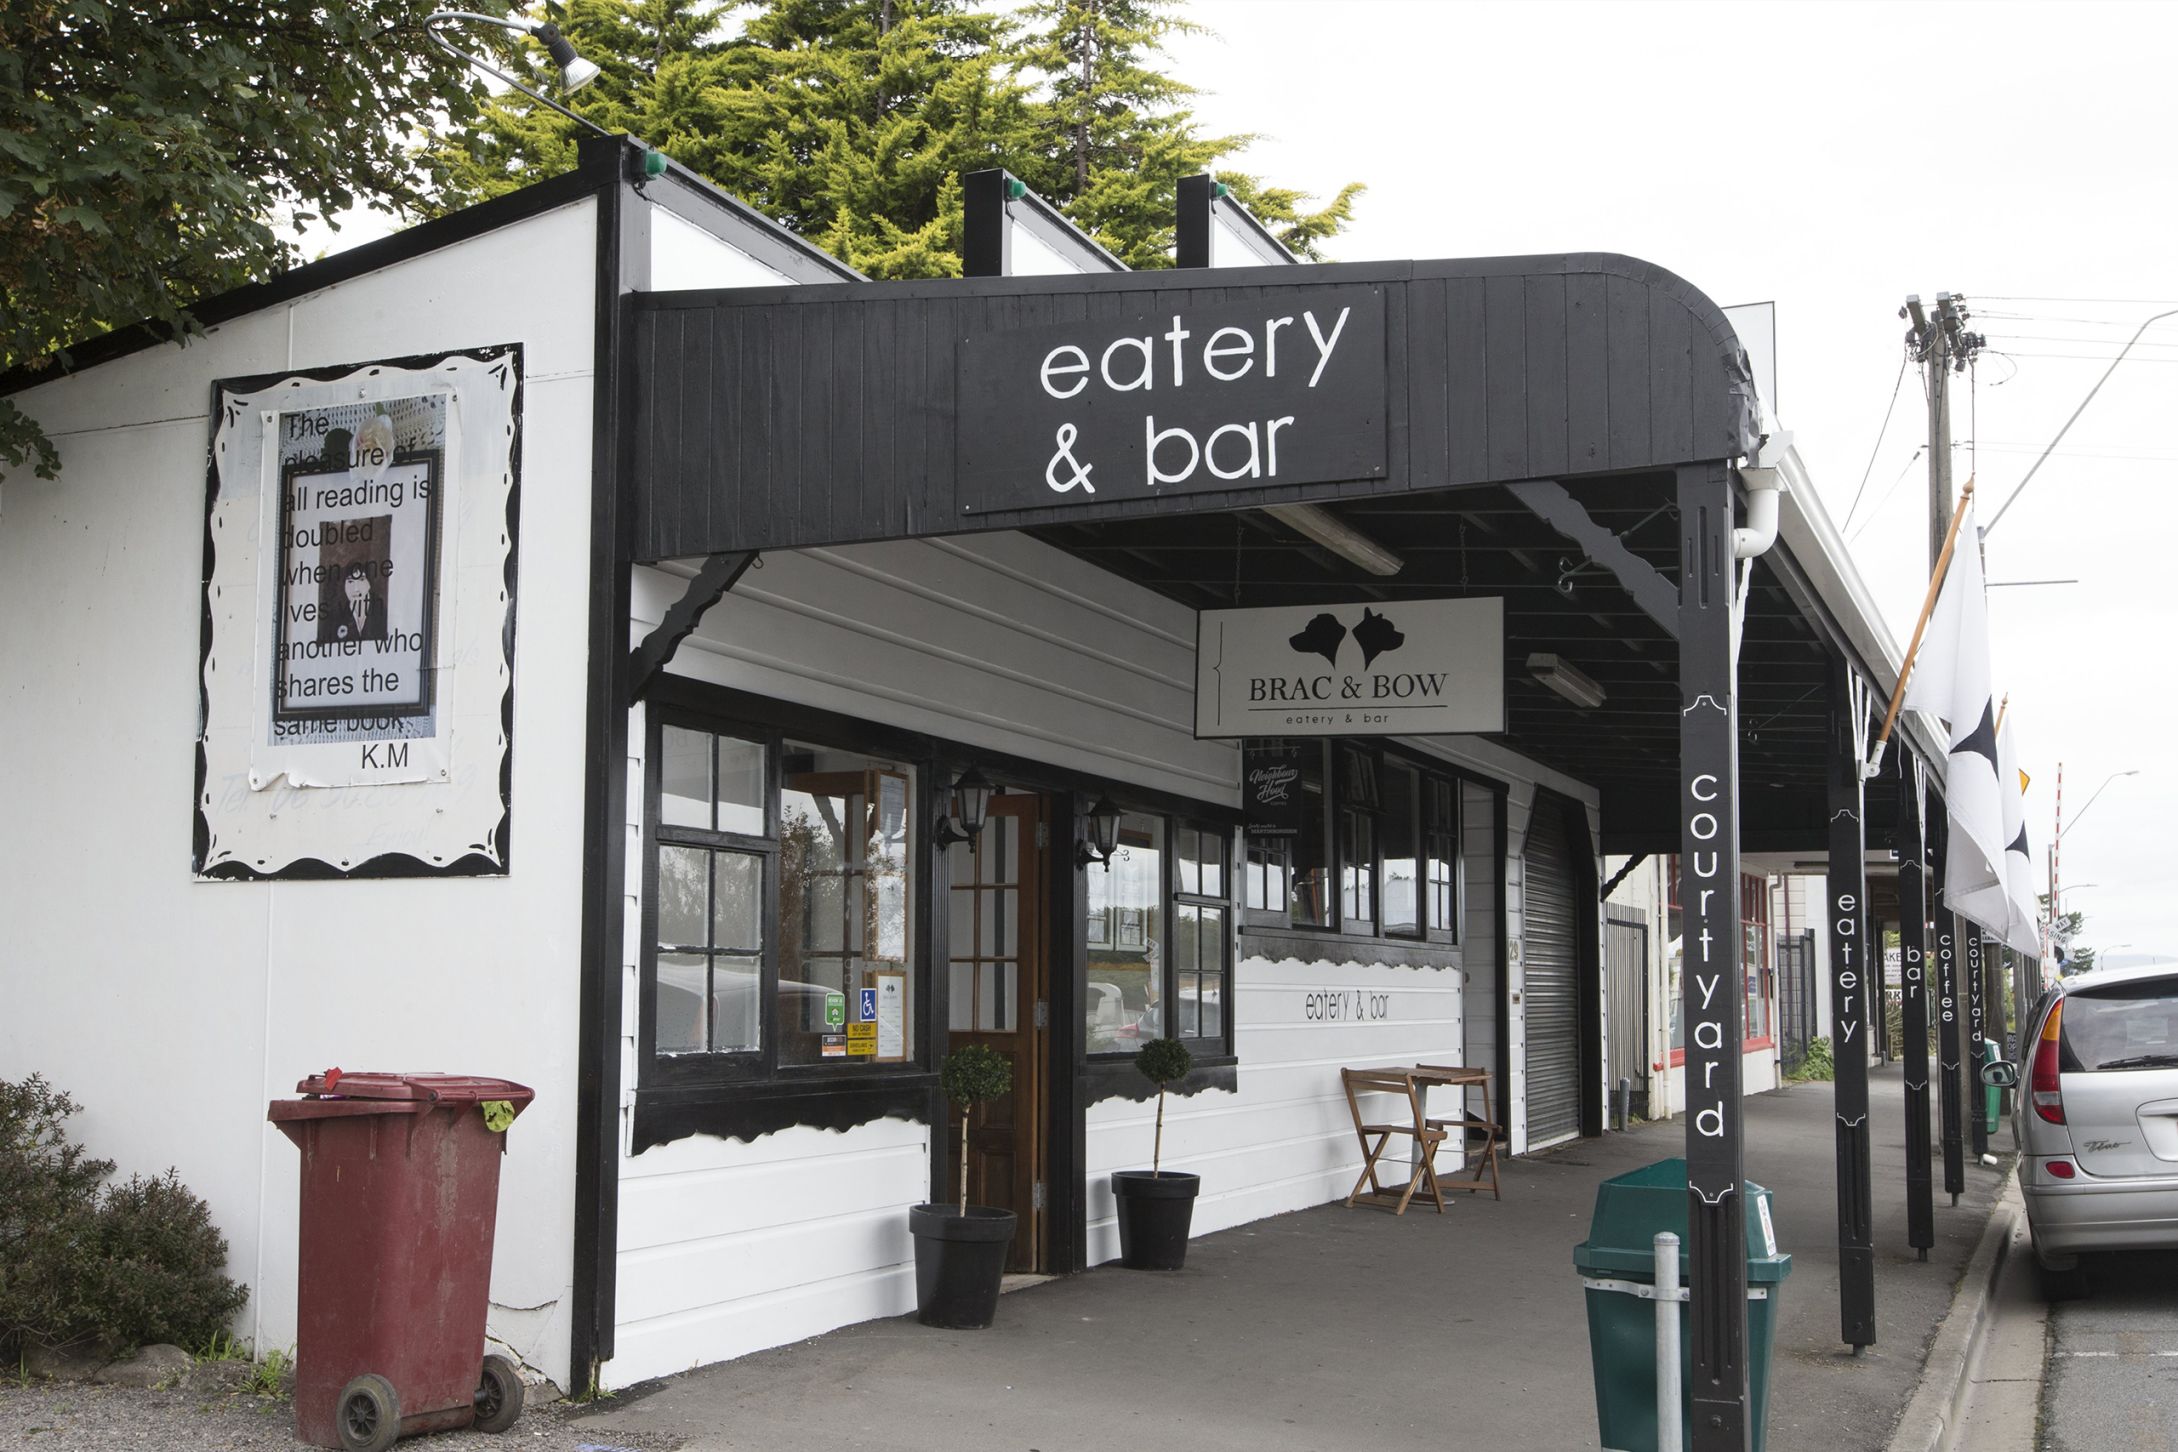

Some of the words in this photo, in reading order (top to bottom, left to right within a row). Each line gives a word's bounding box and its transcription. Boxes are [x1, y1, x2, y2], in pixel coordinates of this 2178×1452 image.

[1040, 307, 1350, 399] eatery
[285, 413, 330, 438] The
[1046, 423, 1096, 493] &
[1146, 416, 1295, 486] bar
[284, 486, 308, 512] all
[316, 479, 404, 508] reading
[413, 475, 432, 500] is
[283, 517, 373, 550] doubled
[350, 558, 394, 583] one
[374, 628, 424, 655] who
[275, 673, 354, 699] shares
[362, 668, 399, 693] the
[1249, 675, 1332, 702] BRAC
[1340, 675, 1363, 699] &
[1372, 673, 1449, 698] BOW
[1286, 715, 1334, 726] eatery
[1344, 714, 1353, 724] &
[1363, 713, 1389, 723] bar
[361, 742, 409, 769] K.M
[1690, 773, 1724, 1138] courtyard
[1836, 894, 1857, 1043] eatery
[1906, 945, 1921, 999] bar
[1940, 934, 1953, 1022] coffee
[1968, 937, 1982, 1042] courtyard
[1306, 987, 1350, 1021] eatery
[1356, 989, 1365, 1021] &
[1369, 989, 1390, 1021] bar
